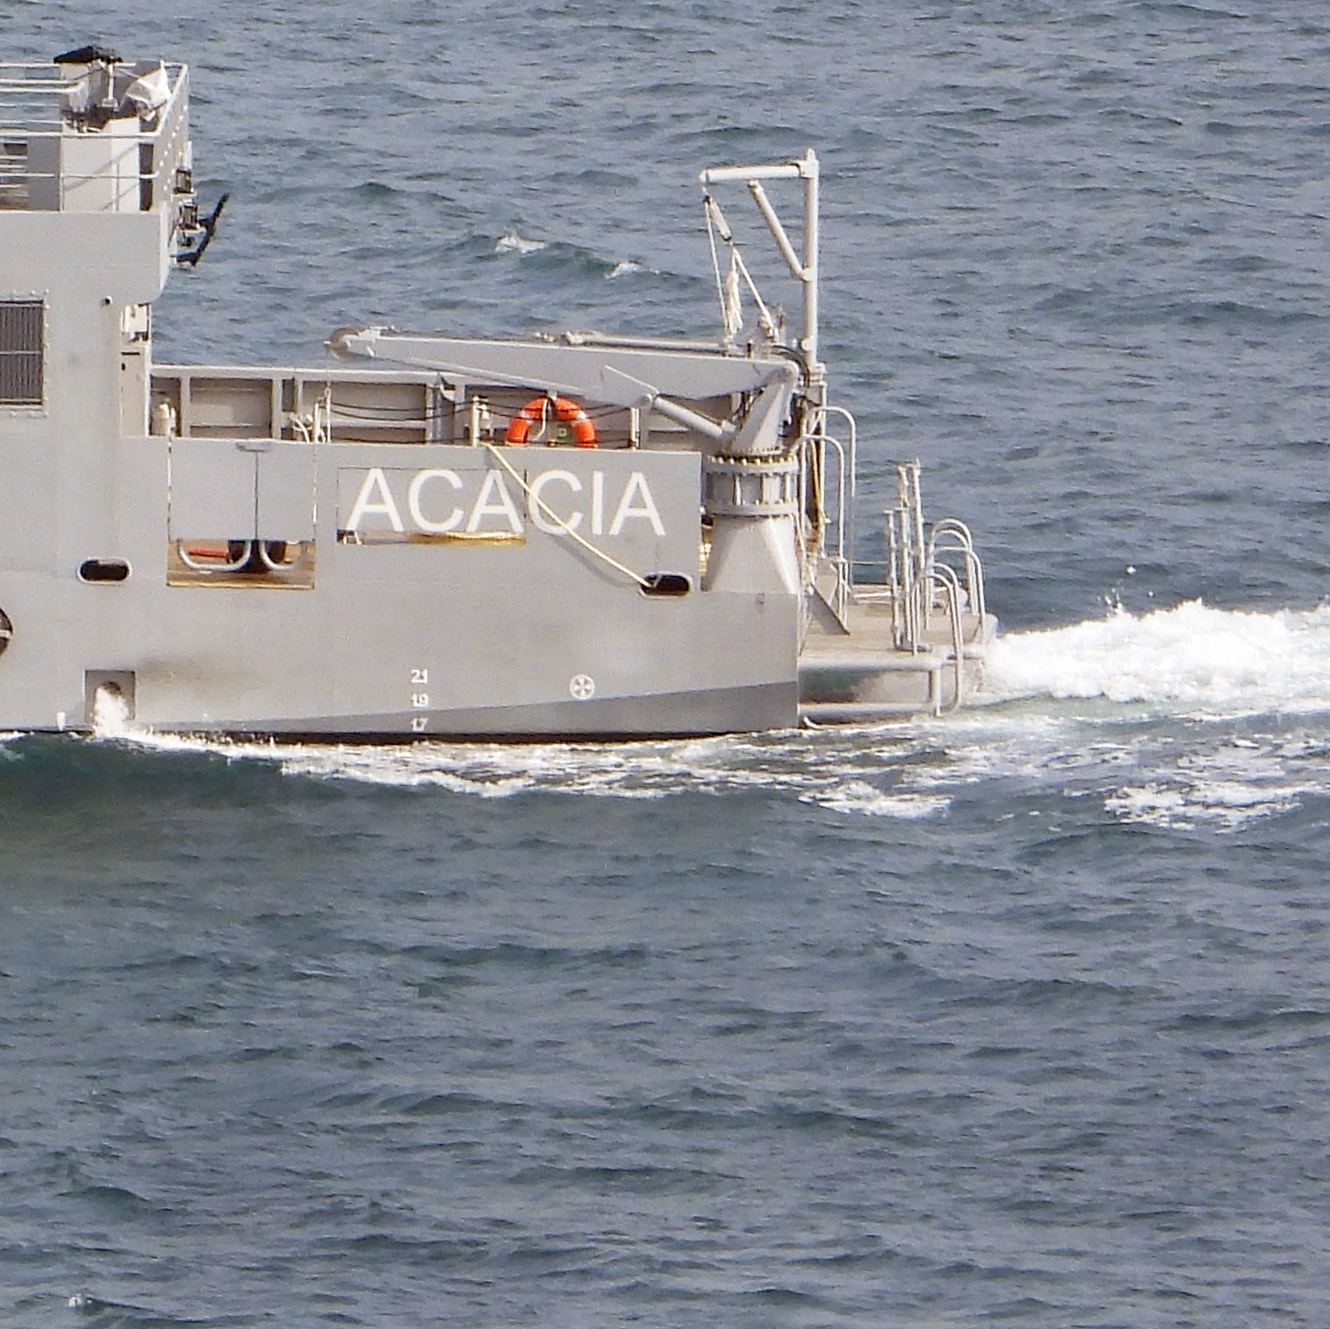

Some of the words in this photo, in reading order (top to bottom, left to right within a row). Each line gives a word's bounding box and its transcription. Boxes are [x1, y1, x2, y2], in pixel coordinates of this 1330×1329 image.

[346, 467, 666, 536] ACACIA
[410, 669, 428, 683] 21
[410, 693, 429, 707] 19
[410, 717, 428, 732] 17
